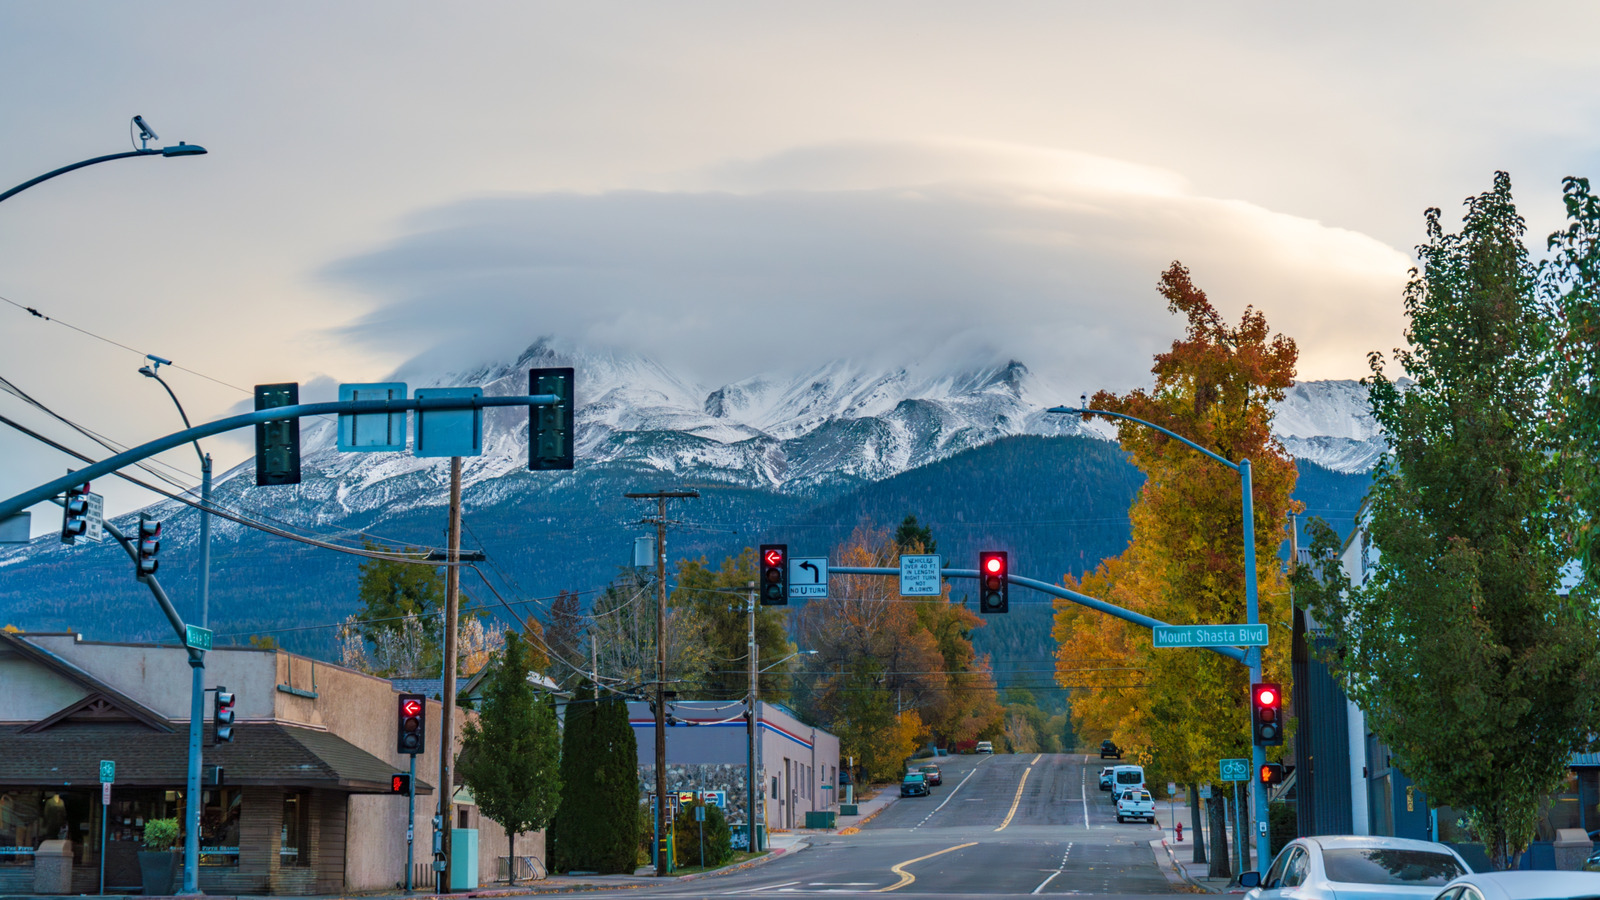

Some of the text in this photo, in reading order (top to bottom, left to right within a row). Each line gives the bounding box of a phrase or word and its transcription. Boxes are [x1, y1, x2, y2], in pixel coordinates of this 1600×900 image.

[800, 586, 807, 595] U
[1158, 628, 1263, 643] Mount Shasta Blvd
